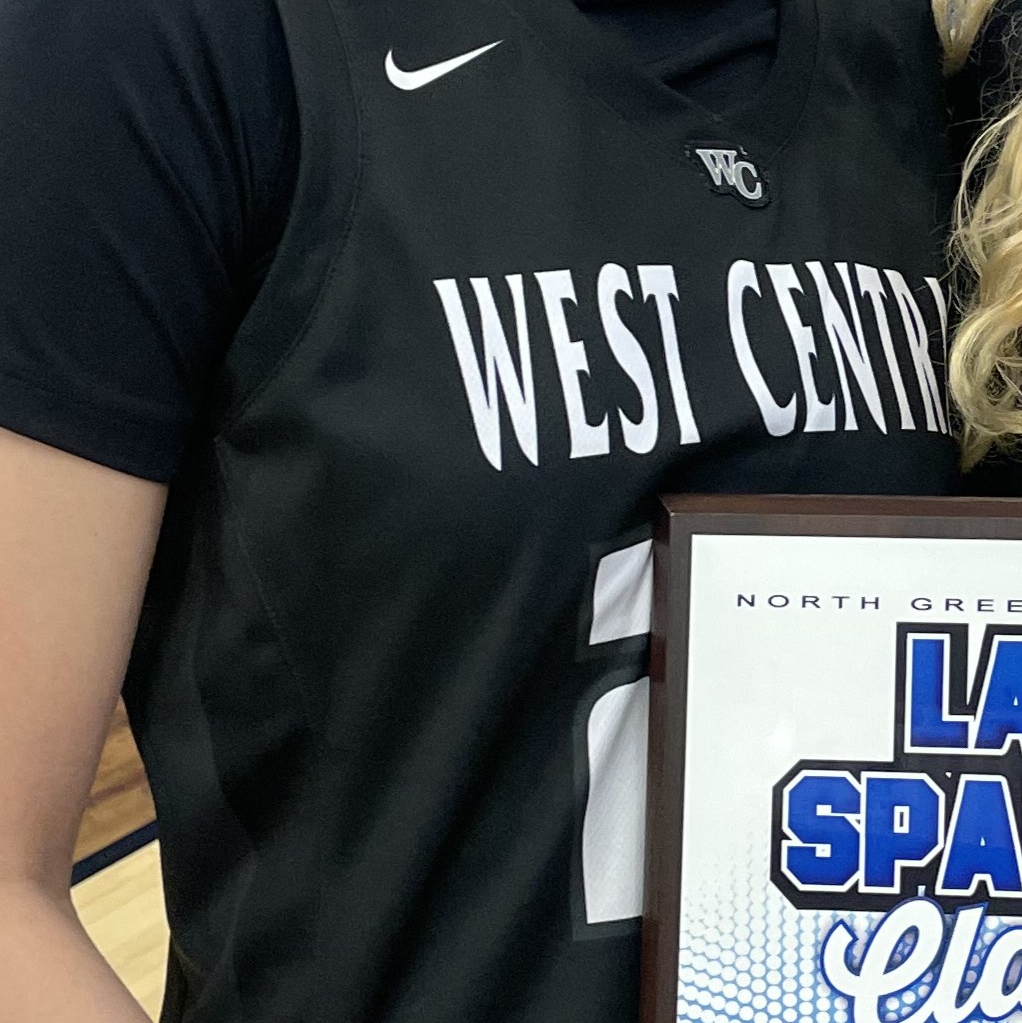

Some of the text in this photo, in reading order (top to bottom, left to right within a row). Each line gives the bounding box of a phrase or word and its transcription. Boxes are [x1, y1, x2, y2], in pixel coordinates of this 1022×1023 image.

[695, 149, 763, 200] WC
[433, 260, 950, 472] WEST CENTR
[736, 594, 880, 610] NORTH
